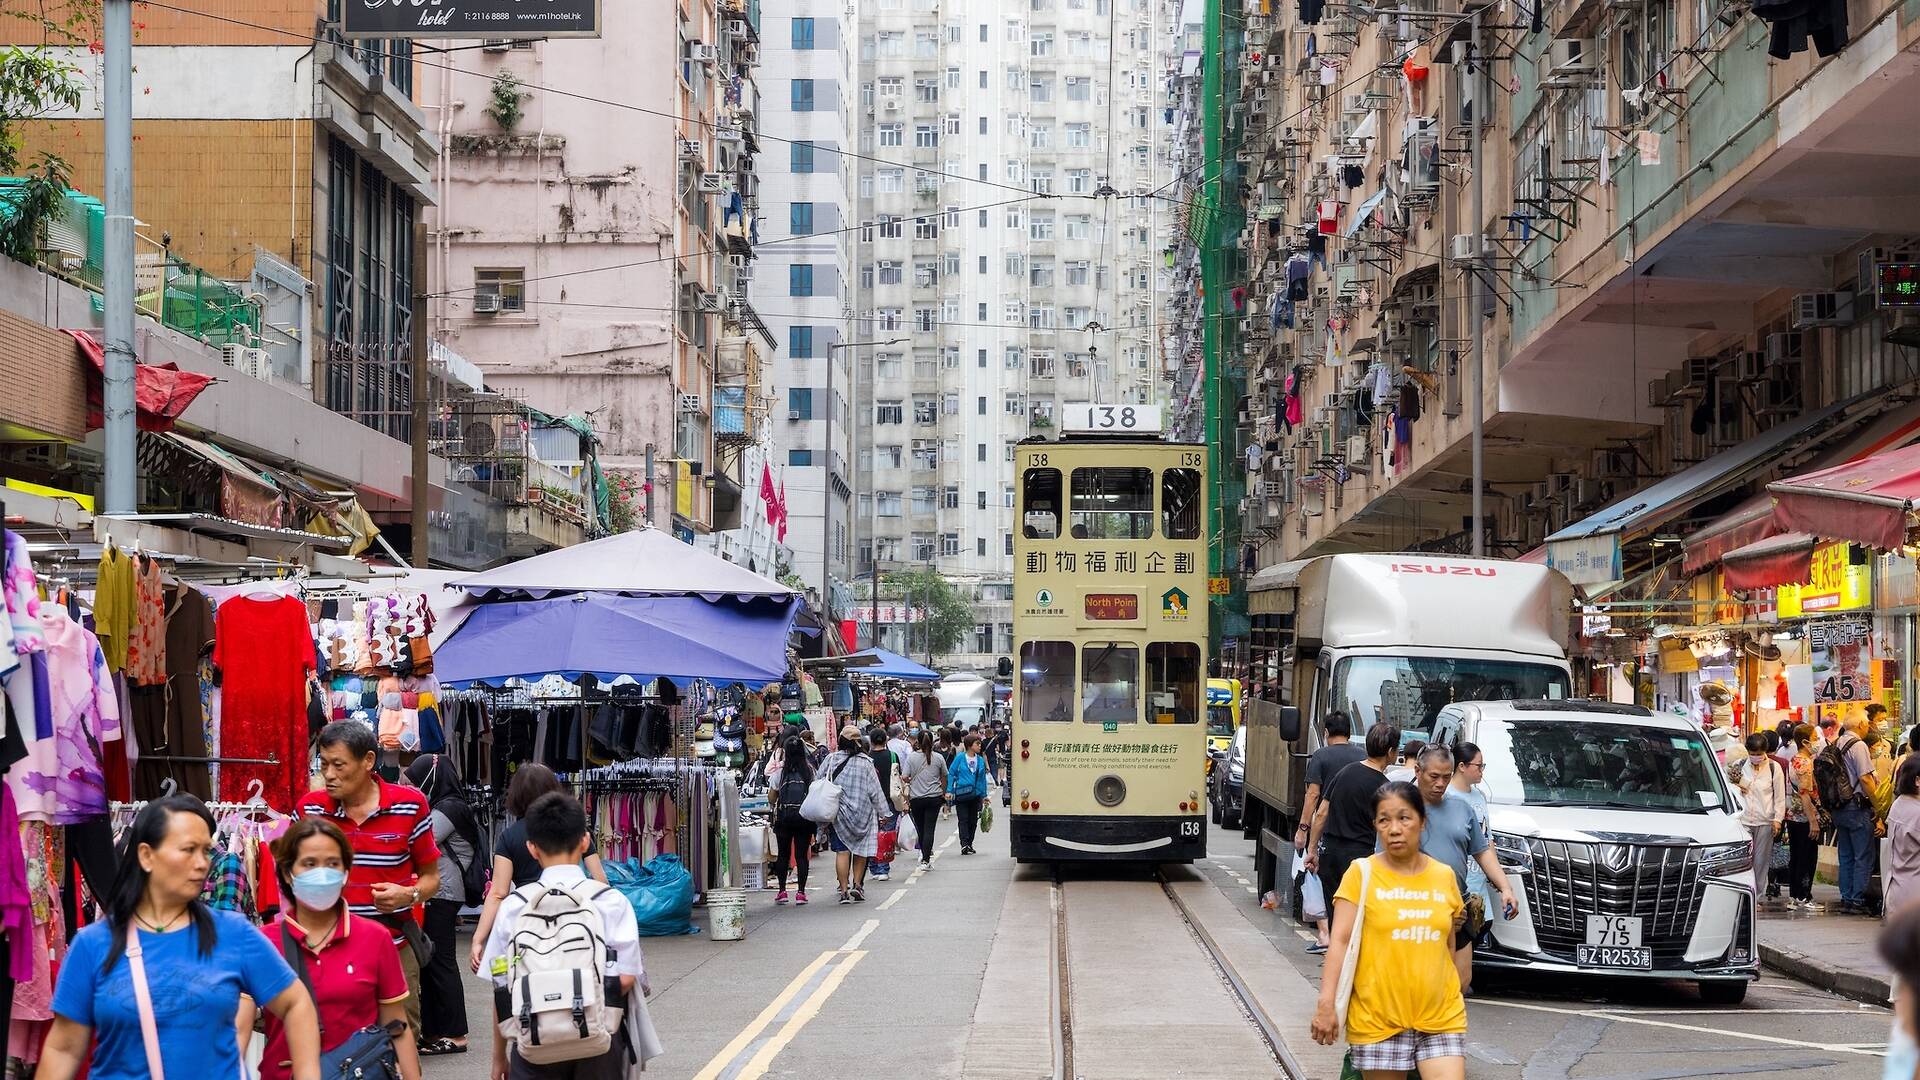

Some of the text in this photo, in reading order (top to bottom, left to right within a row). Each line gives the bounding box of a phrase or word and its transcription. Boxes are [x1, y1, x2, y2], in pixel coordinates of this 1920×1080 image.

[418, 8, 456, 26] hotel
[516, 12, 581, 20] www.m1hotel.hk
[1088, 407, 1137, 428] 138
[1028, 454, 1048, 466] 138
[1181, 453, 1202, 466] 138
[1026, 551, 1194, 573] 動物福利企劃
[1392, 564, 1496, 577] ISUZU
[1087, 597, 1136, 607] North Point
[1811, 624, 1869, 647] 雪花肥牛
[1822, 676, 1855, 700] 45
[1180, 821, 1200, 836] 138
[1375, 887, 1446, 903] believe in
[1398, 908, 1433, 921] your
[1604, 916, 1626, 931] YG
[1391, 925, 1441, 944] selfie
[1598, 930, 1630, 946] 715
